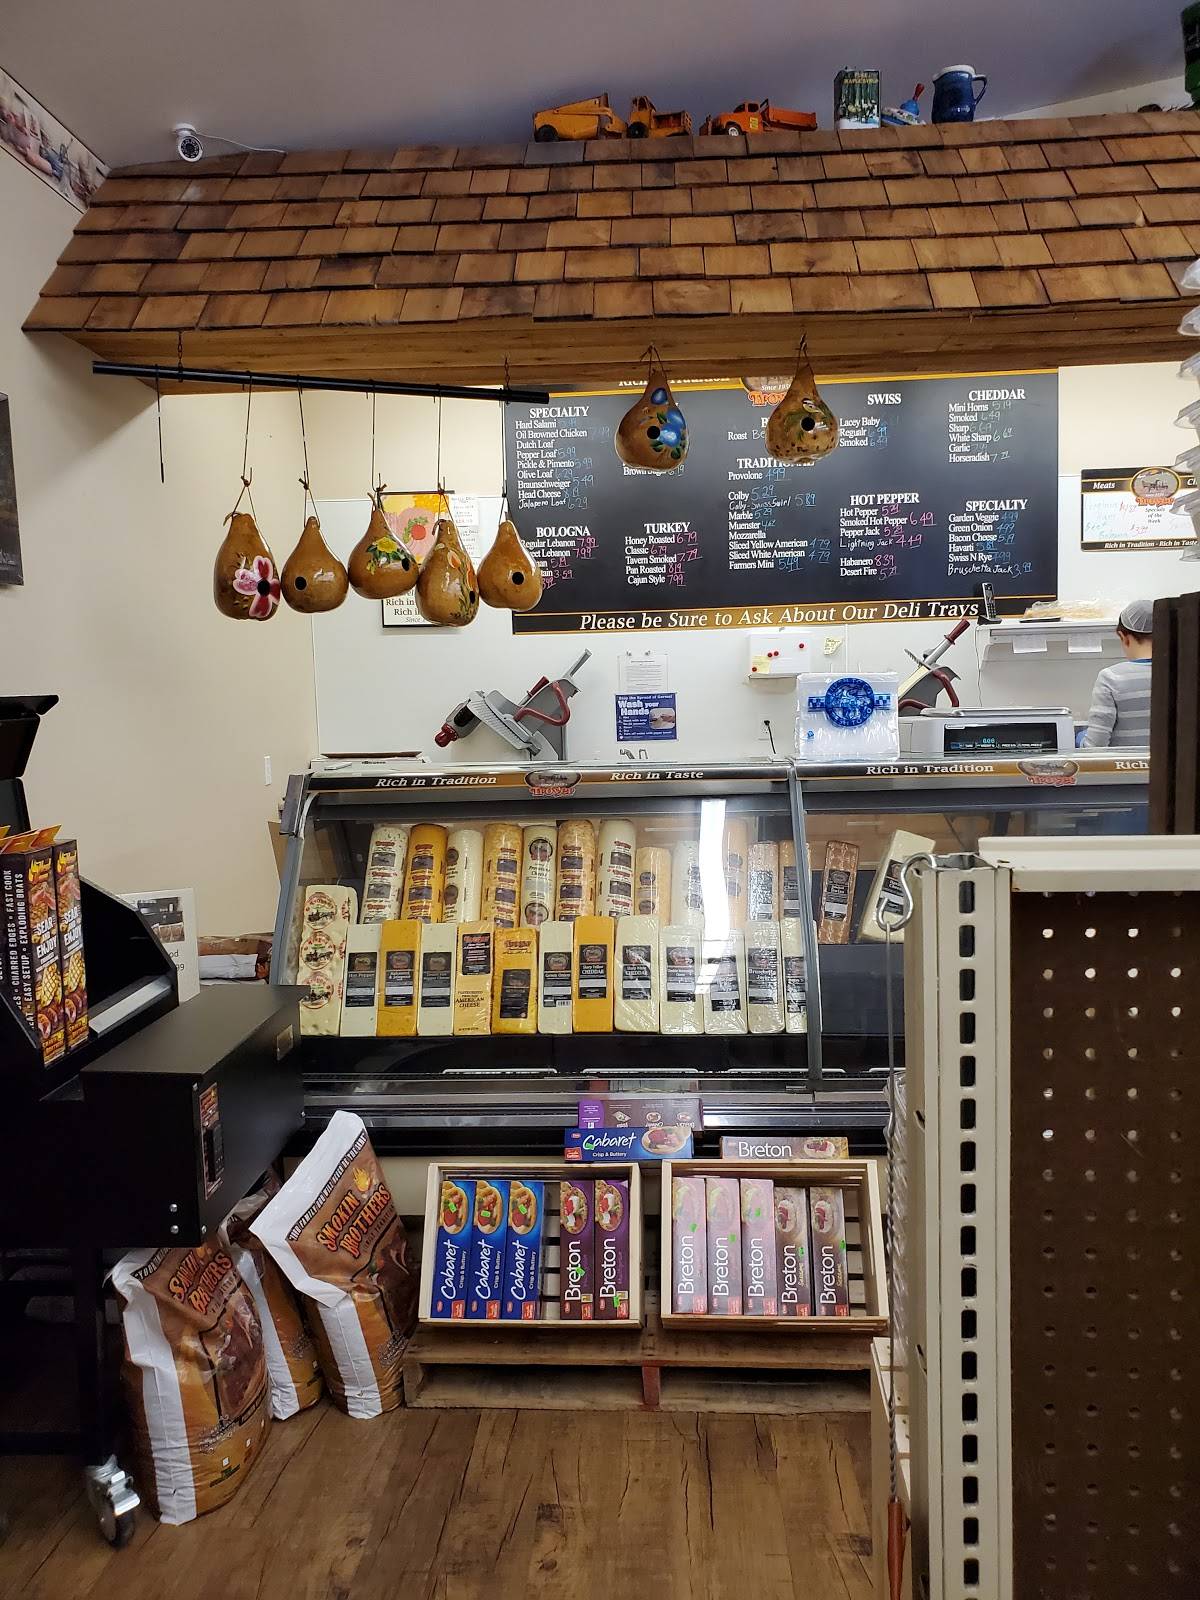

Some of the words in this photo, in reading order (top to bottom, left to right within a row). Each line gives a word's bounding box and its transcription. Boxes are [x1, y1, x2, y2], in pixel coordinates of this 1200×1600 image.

[868, 393, 901, 405] SWISS
[969, 389, 1026, 401] CHEDDAR
[530, 406, 589, 418] SPECIALTY
[949, 403, 965, 412] Mini
[840, 418, 860, 428] Lacey
[862, 417, 880, 427] Baby
[949, 413, 977, 422] Smoked
[516, 421, 532, 429] Hard
[534, 420, 556, 428] Salami
[949, 424, 969, 433] Sharp
[516, 431, 527, 439] Oil
[528, 430, 559, 438] Browned
[559, 429, 587, 437] Chicken
[728, 432, 747, 441] Roast
[949, 434, 970, 442] White
[971, 433, 991, 443] Sharp
[517, 441, 536, 449] Dutch
[538, 440, 555, 448] Loaf
[840, 437, 868, 447] Smoked
[949, 443, 970, 452] Garlic
[517, 451, 540, 460] Pepper
[541, 450, 558, 458] Loaf
[949, 452, 990, 462] Horseradish
[517, 460, 537, 469] Pickle
[547, 459, 574, 468] Pimento
[517, 470, 536, 479] Olive
[537, 470, 554, 478] Loaf
[728, 471, 762, 481] Provolone
[518, 480, 571, 489] Braunschweiger
[519, 490, 536, 498] Head
[728, 491, 749, 501] Colby
[850, 494, 875, 506] HOT
[877, 493, 920, 504] PEPPER
[551, 498, 566, 506] Loaf
[966, 499, 1028, 511] SPECIALTY
[729, 511, 753, 520] Marble
[840, 508, 853, 516] Hot
[854, 508, 878, 518] Pepper
[949, 514, 974, 522] Garden
[975, 512, 999, 523] Veggie
[729, 521, 760, 530] Muenster
[840, 518, 868, 526] Smoked
[870, 517, 883, 525] Hot
[884, 517, 907, 526] Pepper
[536, 526, 590, 537] BOLOGNA
[644, 522, 690, 534] TURKEY
[840, 528, 864, 538] Pepper
[865, 527, 880, 535] Jack
[949, 524, 970, 532] Green
[971, 523, 993, 531] Onion
[625, 537, 647, 547] Honey
[649, 534, 675, 544] Roasted
[729, 531, 766, 540] Mozzarella
[949, 534, 971, 542] Bacon
[972, 533, 997, 541] Cheese
[521, 539, 546, 550] Regular
[547, 539, 576, 547] Lebanon
[729, 541, 750, 550] Sliced
[750, 541, 774, 549] Yellow
[775, 539, 808, 548] American
[949, 543, 974, 552] Havarti
[542, 549, 570, 557] Lebanon
[625, 546, 649, 555] Classic
[729, 551, 750, 560] Sliced
[750, 550, 772, 559] White
[772, 549, 805, 558] American
[625, 556, 648, 565] Tavern
[649, 554, 677, 564] Smoked
[840, 558, 873, 566] Habanero
[949, 553, 968, 562] Swiss
[970, 553, 977, 561] N
[978, 553, 992, 563] Rye
[626, 566, 638, 574] Pan
[640, 565, 666, 573] Roasted
[729, 561, 756, 570] Farmers
[758, 560, 774, 568] Mini
[993, 565, 1013, 575] Jack
[840, 568, 862, 576] Desert
[864, 567, 877, 575] Fire
[628, 576, 647, 585] Cajun
[649, 575, 665, 585] Style
[580, 614, 635, 630] Please
[641, 613, 662, 629] be
[668, 612, 707, 628] Sure
[715, 612, 732, 626] to
[737, 609, 774, 625] Ask
[778, 608, 836, 623] About
[842, 605, 878, 620] Our
[882, 603, 920, 619] Deli
[927, 603, 979, 619] Trays
[618, 700, 643, 708] Wash
[866, 765, 899, 775] Rich
[903, 765, 918, 774] in
[923, 763, 994, 773] Tradition
[1114, 760, 1149, 770] Rich
[610, 772, 642, 780] Rich
[665, 770, 703, 779] Taste
[376, 778, 408, 787] Rich
[412, 778, 426, 786] in
[431, 775, 497, 786] Tradition
[4, 870, 12, 890] COOK
[15, 874, 23, 895] BRATS
[6, 892, 14, 912] FAST
[16, 900, 28, 943] EXPLODING
[37, 916, 53, 936] SEAR
[8, 922, 16, 948] EDGES
[64, 925, 81, 946] ENJOY
[36, 935, 57, 959] ENJOY
[10, 950, 20, 985] CHARRED
[21, 955, 31, 982] SETUP
[24, 983, 33, 1001] EASY
[583, 1132, 636, 1150] Cabaret
[738, 1141, 792, 1157] Breton
[316, 1190, 360, 1252] SMOKIN
[340, 1183, 391, 1259] BROTHERS
[440, 1239, 459, 1299] Cabaret
[475, 1239, 494, 1299] Cabaret
[510, 1240, 528, 1300] Cabaret
[565, 1240, 581, 1300] Breton
[600, 1237, 616, 1297] Breton
[678, 1236, 694, 1293] Breton
[713, 1237, 729, 1295] Breton
[748, 1238, 764, 1296] Breton
[782, 1244, 797, 1302] Breton
[820, 1246, 836, 1303] Breton
